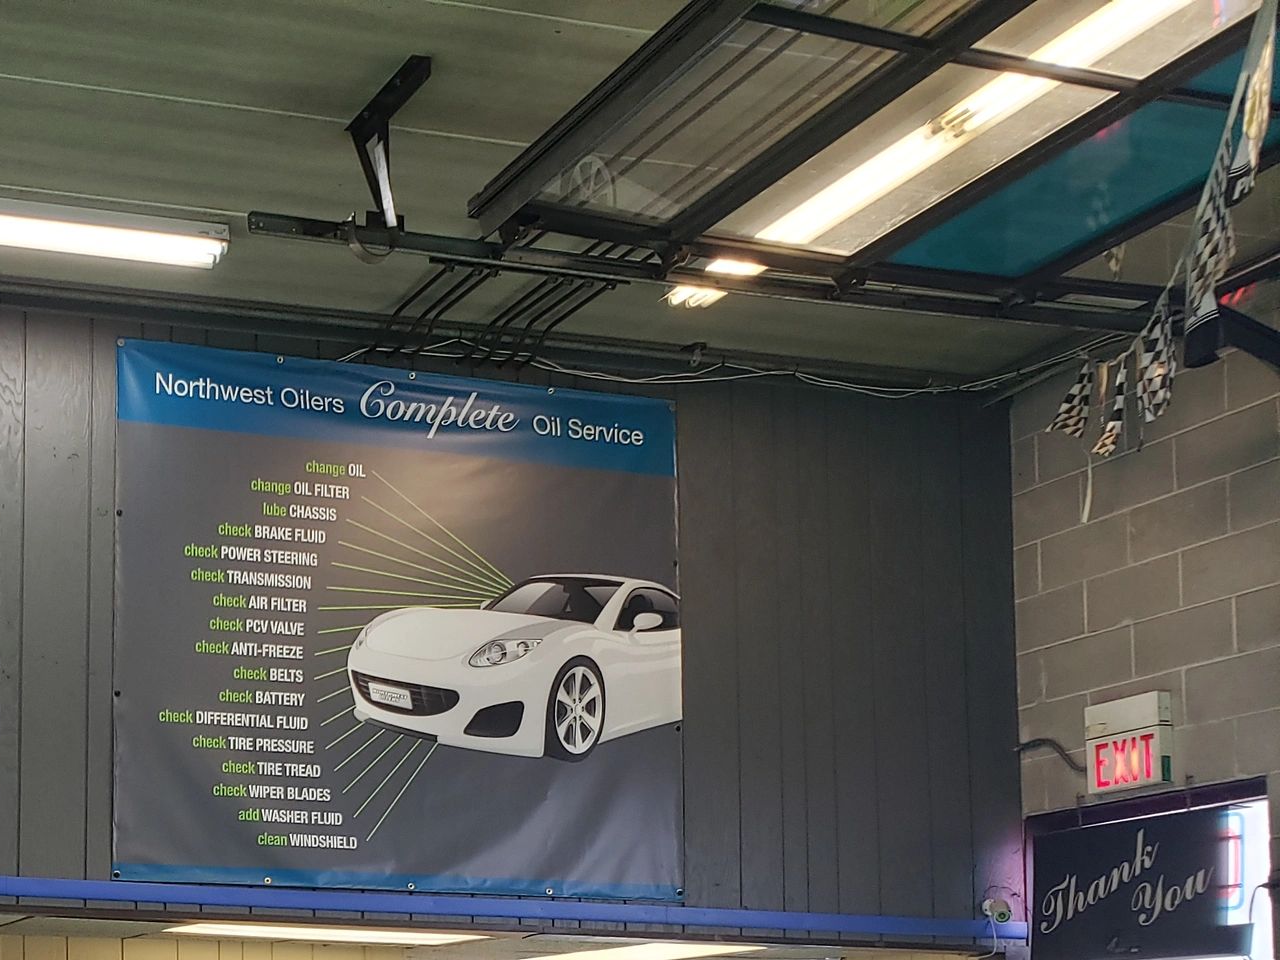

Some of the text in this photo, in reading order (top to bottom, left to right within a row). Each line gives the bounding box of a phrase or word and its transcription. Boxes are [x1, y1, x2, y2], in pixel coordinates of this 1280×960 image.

[153, 371, 645, 447] Northwest Oilers Complete Oil Service
[305, 460, 367, 477] change OIL
[250, 478, 350, 500] change OIL FILTER
[263, 502, 337, 521] lube CHASSIS
[218, 522, 326, 544] check BRAKE FLUID
[184, 543, 318, 567] check POWER STEERING
[190, 567, 312, 589] check TRANSMISSION
[212, 593, 307, 613] check AIR FILTER
[209, 617, 305, 636] check PCV VALVE
[195, 640, 304, 659] check ANTI-FREEZE
[233, 666, 304, 683] check BELTS
[219, 689, 306, 707] check BATTERY
[158, 709, 308, 730] check DIFFERENTIAL FLUID
[192, 735, 314, 754] check TIRE PRESSURE
[222, 760, 321, 778] check TIRE TREAD
[1094, 733, 1155, 789] EXIT
[212, 784, 331, 801] check WIPER BLADES
[238, 807, 343, 826] add WASHER FLUID
[257, 832, 358, 850] clean WINDSHIELD
[1040, 827, 1160, 935] Thank
[1131, 866, 1215, 926] You
